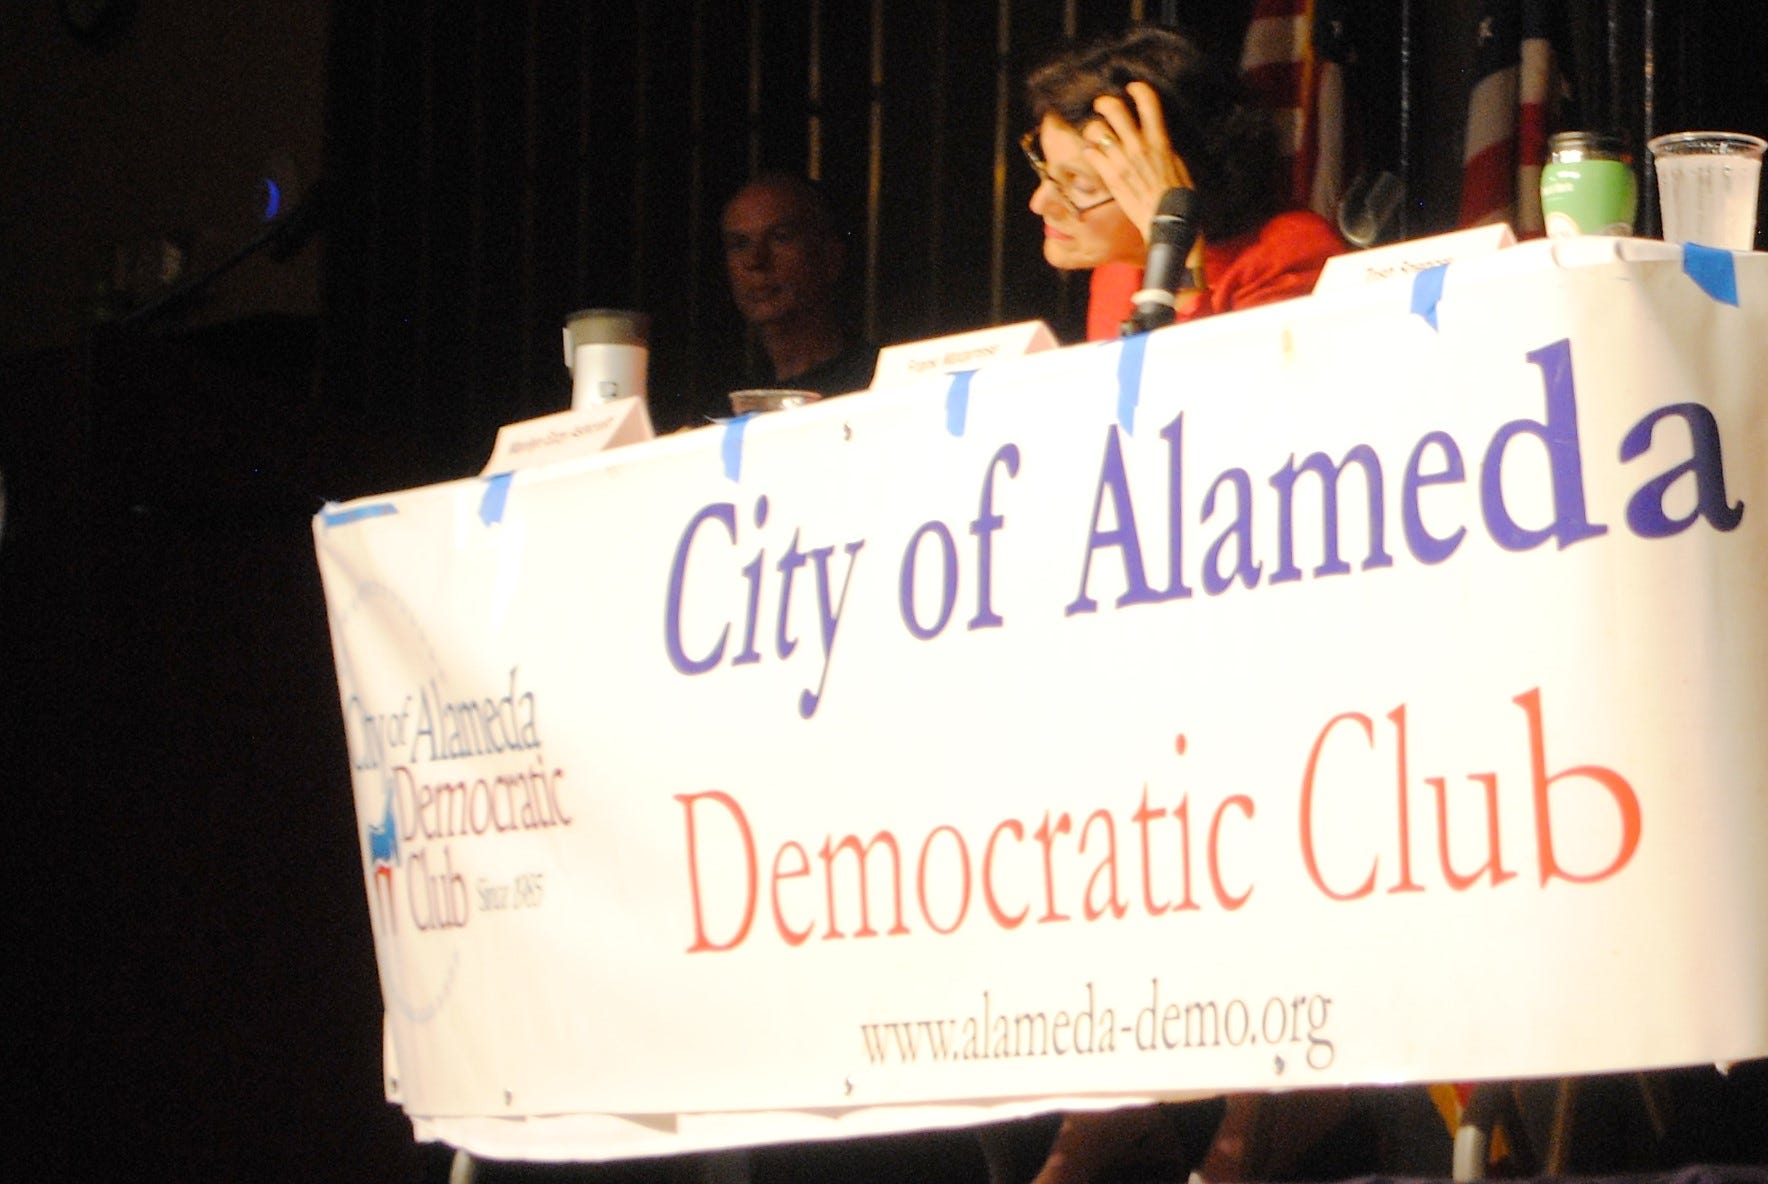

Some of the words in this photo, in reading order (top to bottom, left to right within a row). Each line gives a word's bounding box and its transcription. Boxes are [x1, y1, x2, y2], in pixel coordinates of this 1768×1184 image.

[663, 494, 865, 720] City
[899, 442, 1021, 641] of
[1064, 337, 1746, 618] Alameda
[388, 694, 412, 748] of
[411, 664, 542, 764] Alameda
[393, 753, 574, 842] Democratic
[672, 732, 1256, 955] Democratic
[1299, 686, 1643, 903] Club
[405, 846, 469, 932] Club
[859, 976, 1336, 1071] www.alameda-demo.org
